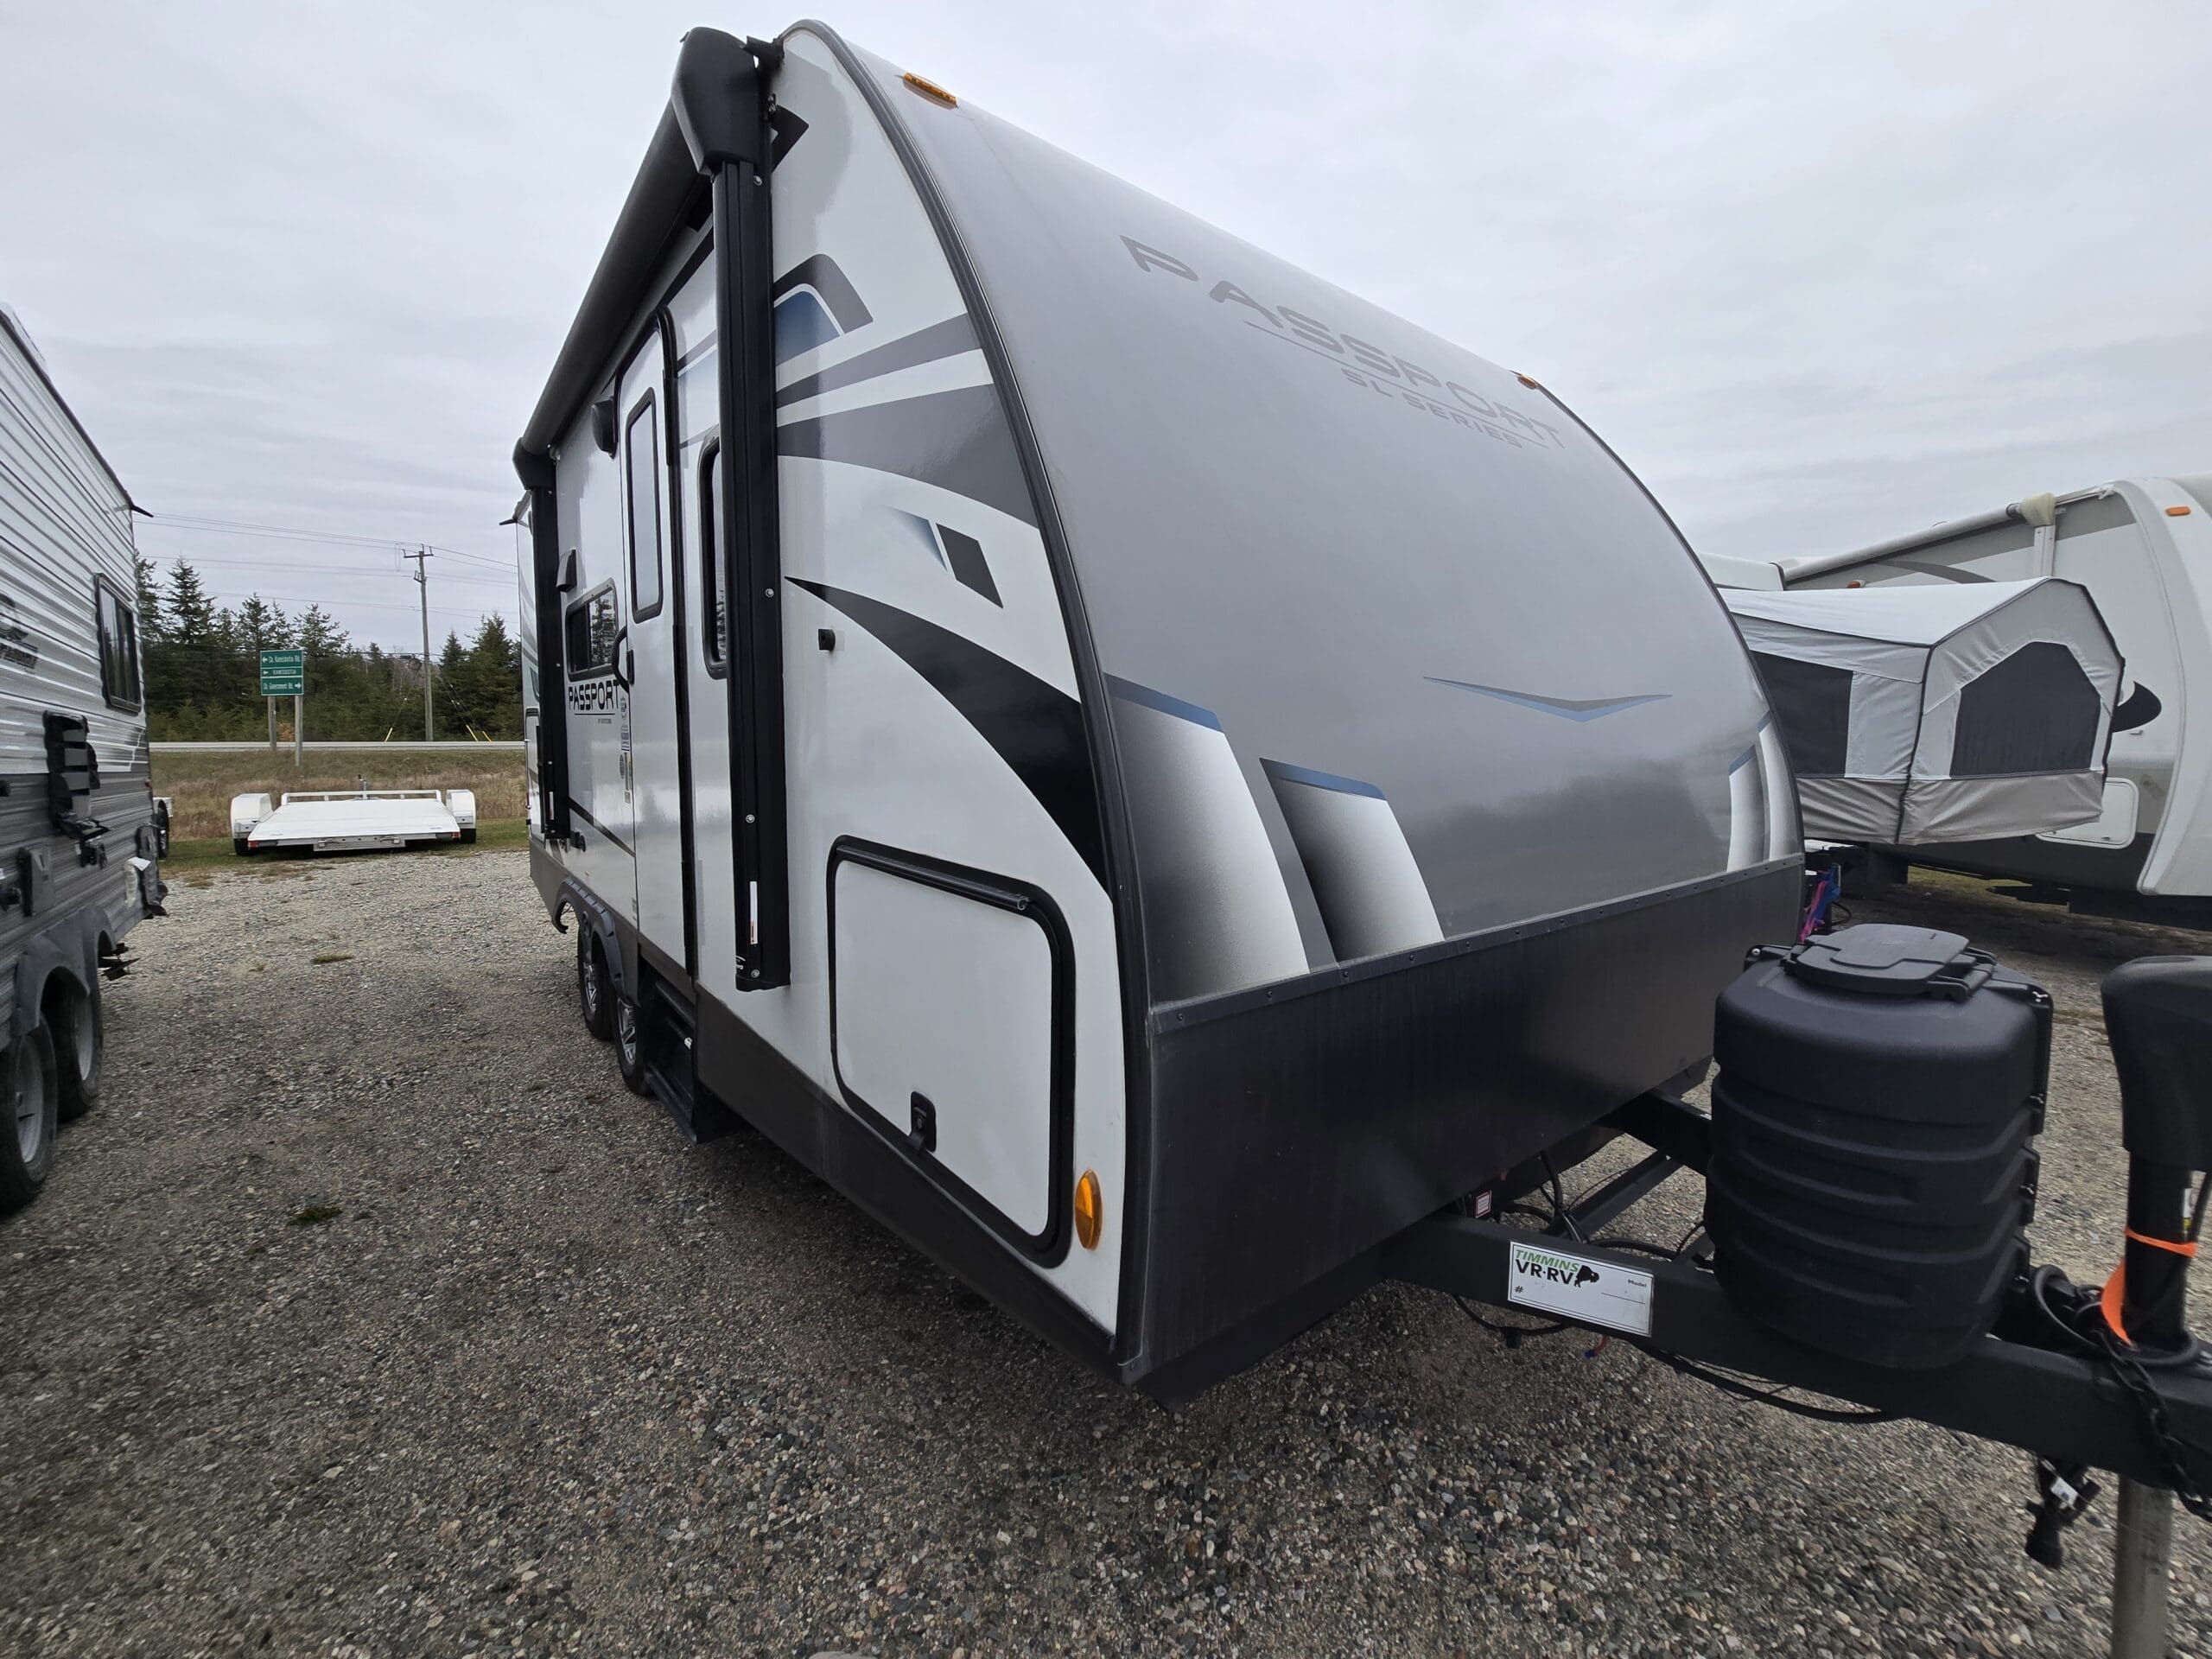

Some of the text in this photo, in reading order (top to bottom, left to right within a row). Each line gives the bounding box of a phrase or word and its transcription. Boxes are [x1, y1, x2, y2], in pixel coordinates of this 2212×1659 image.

[1119, 234, 1566, 449] PASSPORT
[1341, 367, 1522, 448] SL SERIES
[569, 679, 620, 711] PASSPORT
[1516, 1249, 1580, 1272] TIMMINS
